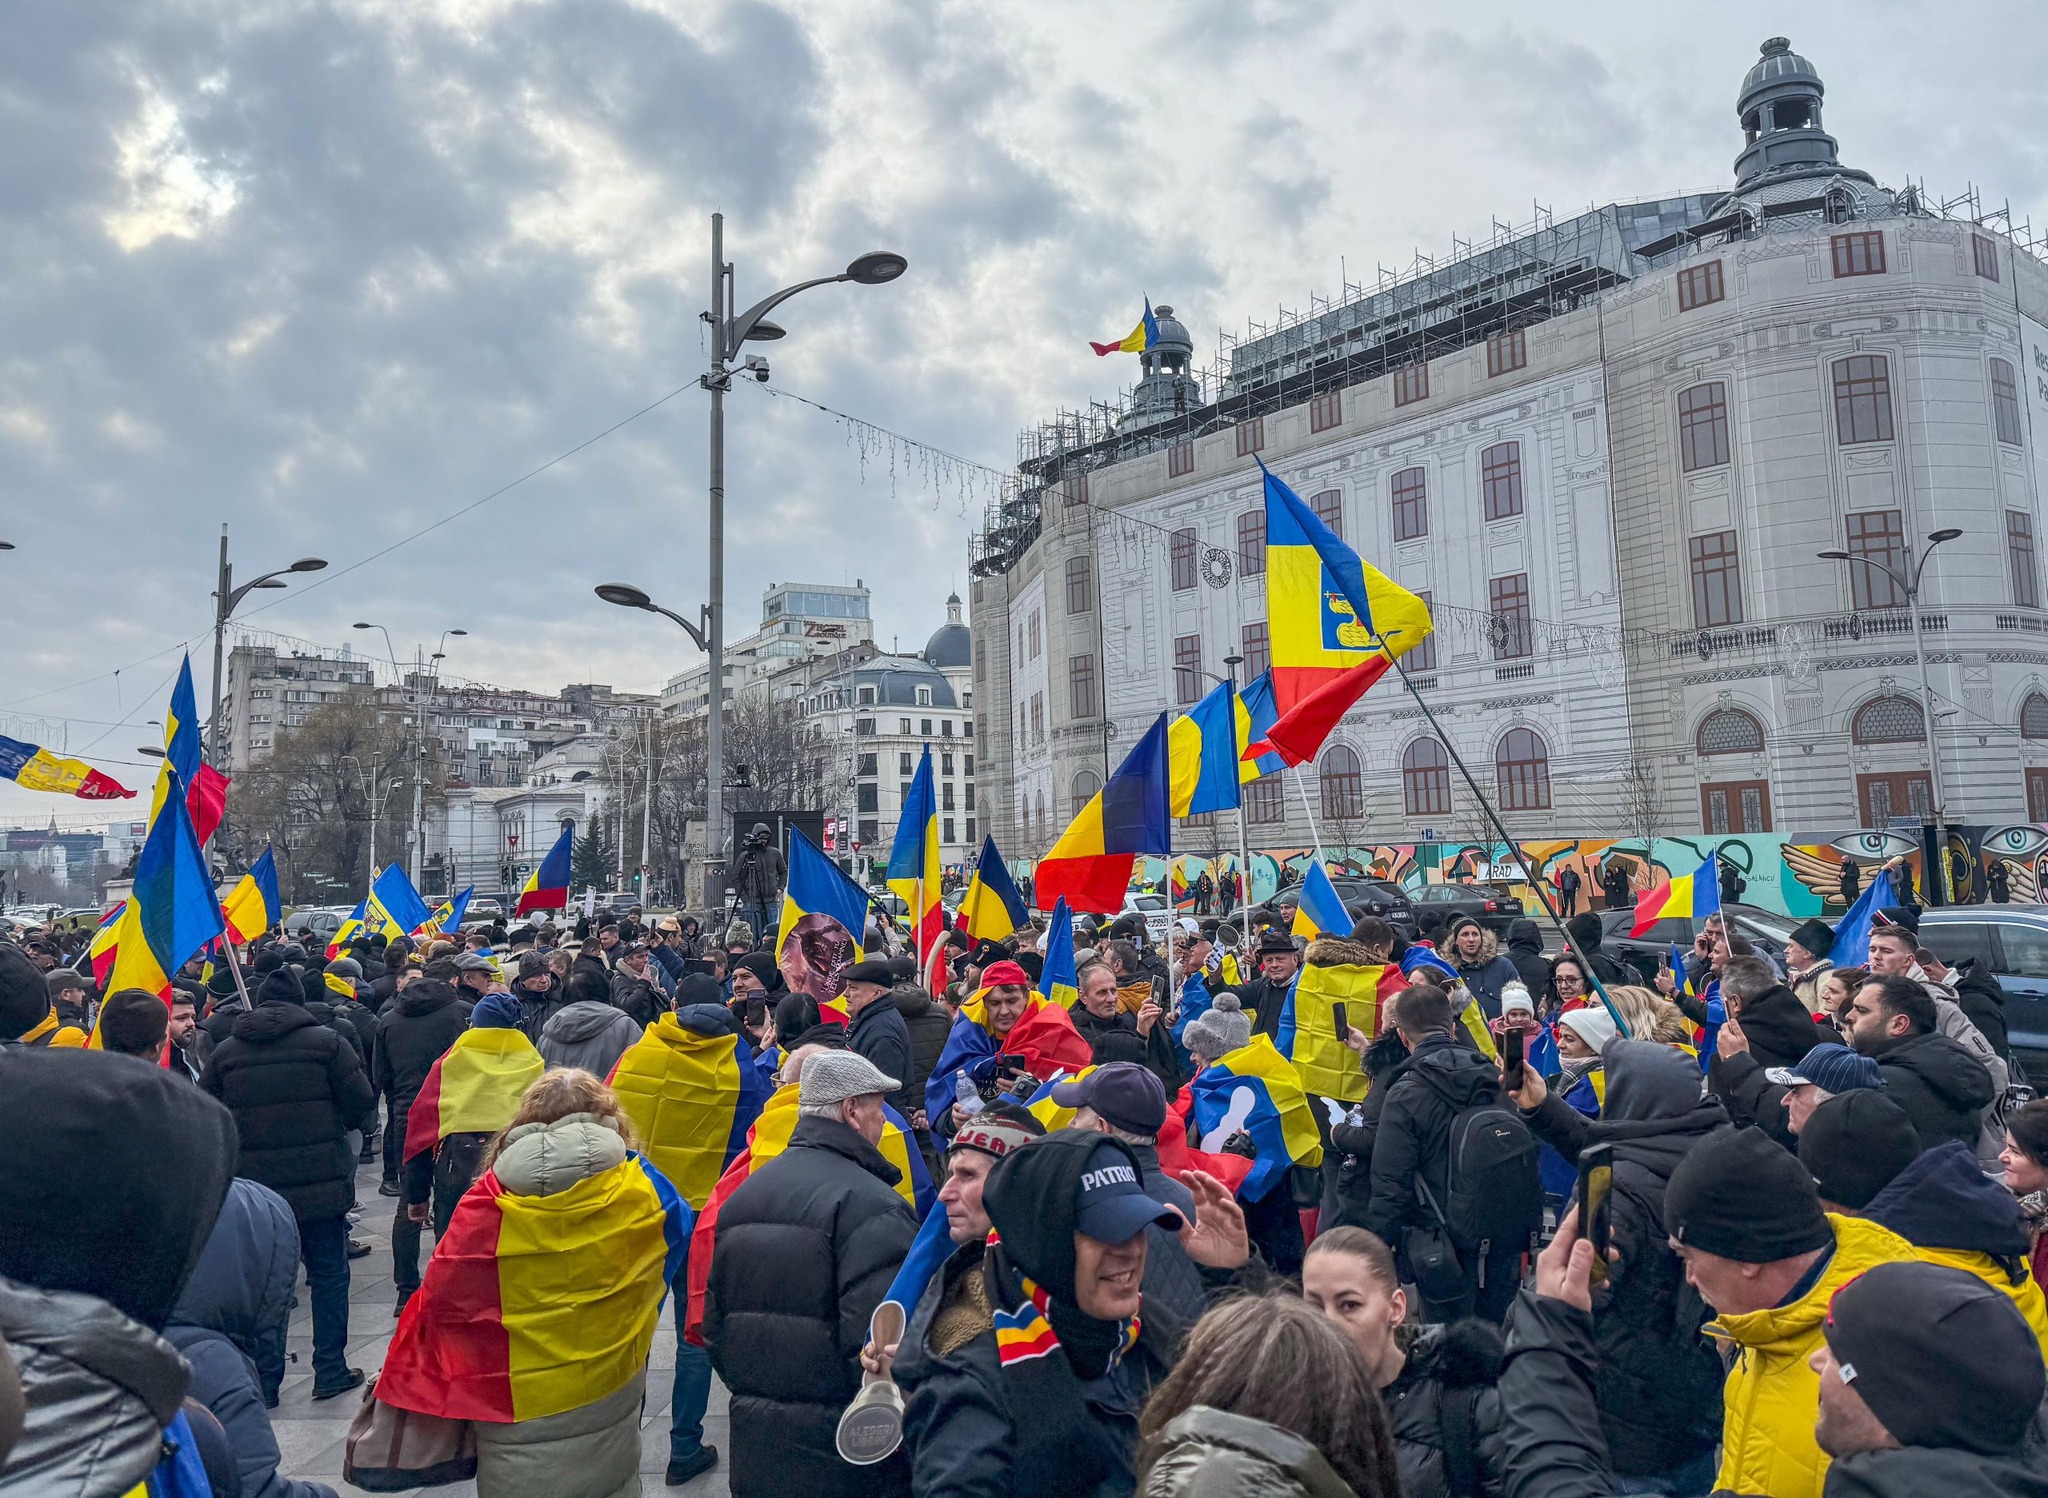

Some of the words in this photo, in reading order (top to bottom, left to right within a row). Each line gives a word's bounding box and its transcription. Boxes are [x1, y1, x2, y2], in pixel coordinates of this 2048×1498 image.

[804, 623, 817, 638] Z
[1485, 865, 1512, 879] ARAD
[1081, 1165, 1137, 1192] PATRIO
